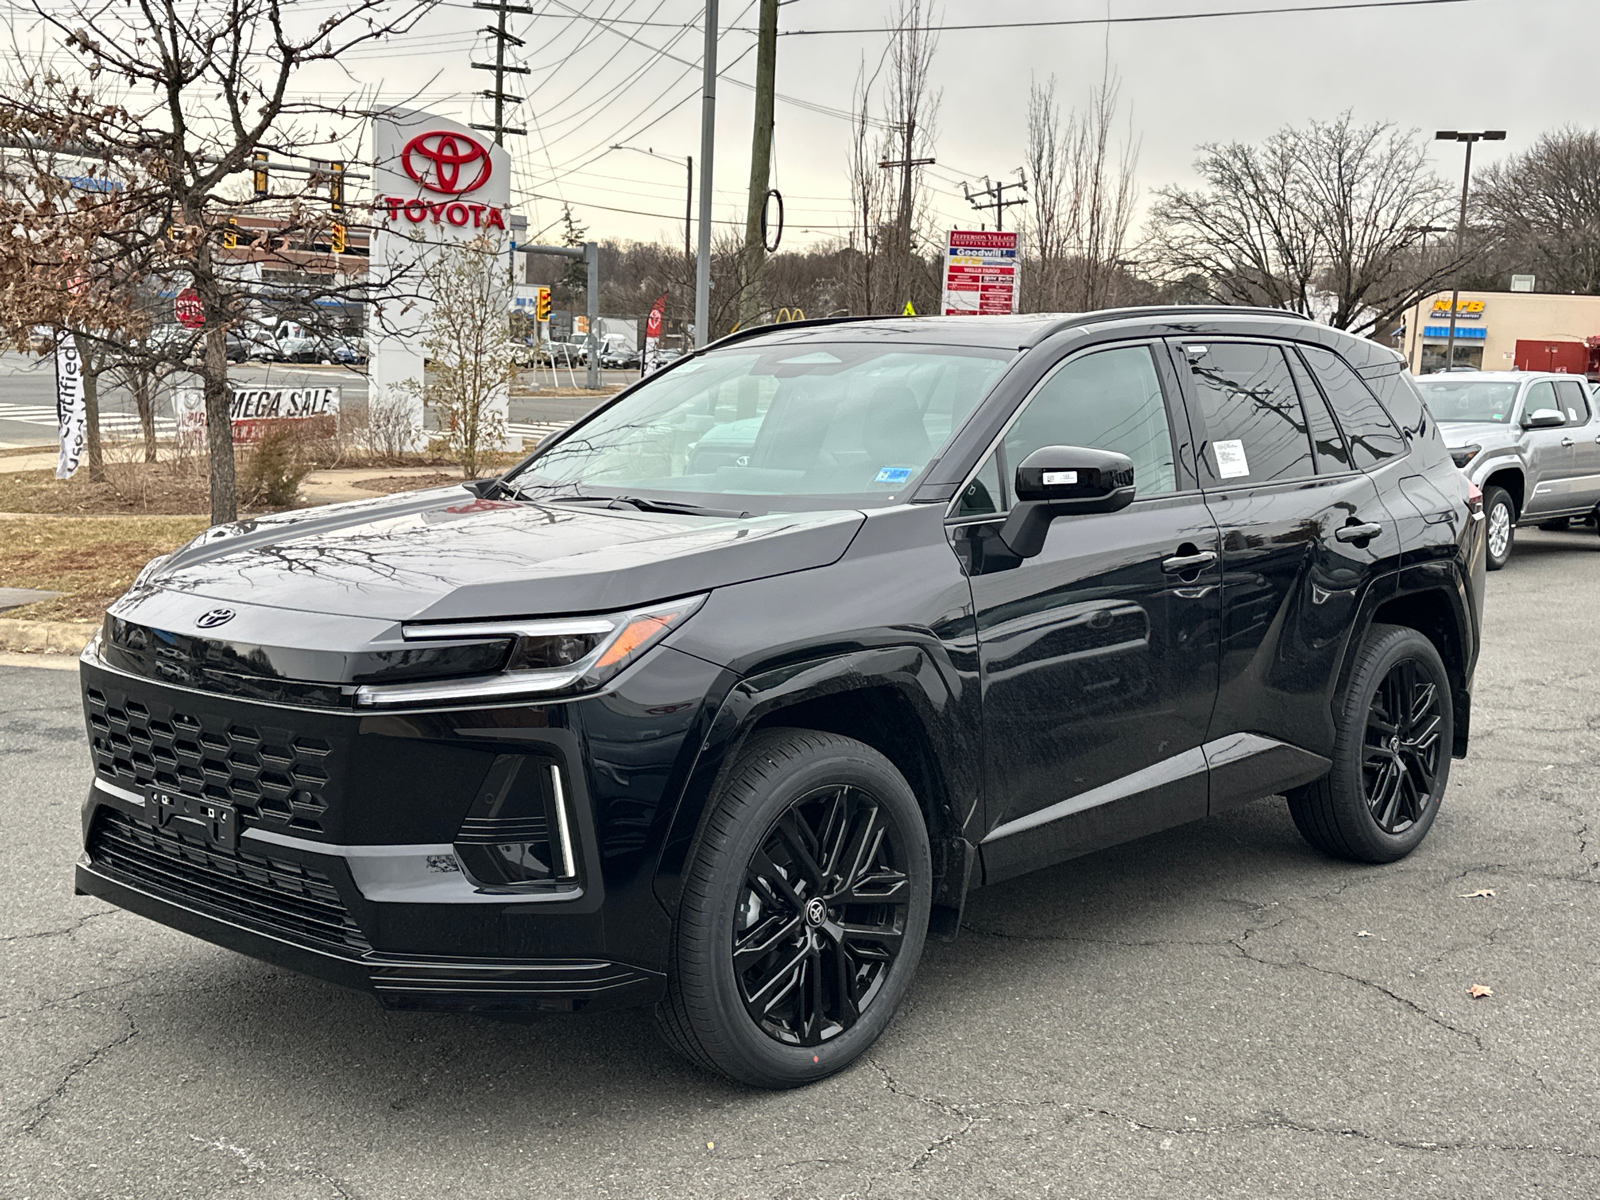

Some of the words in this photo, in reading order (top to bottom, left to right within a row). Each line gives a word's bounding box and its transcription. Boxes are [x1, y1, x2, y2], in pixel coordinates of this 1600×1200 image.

[385, 198, 505, 229] TOYOTA
[956, 248, 1001, 257] Goodwill
[1432, 300, 1486, 313] NTB
[231, 392, 282, 418] MEGA
[287, 389, 332, 417] SALE
